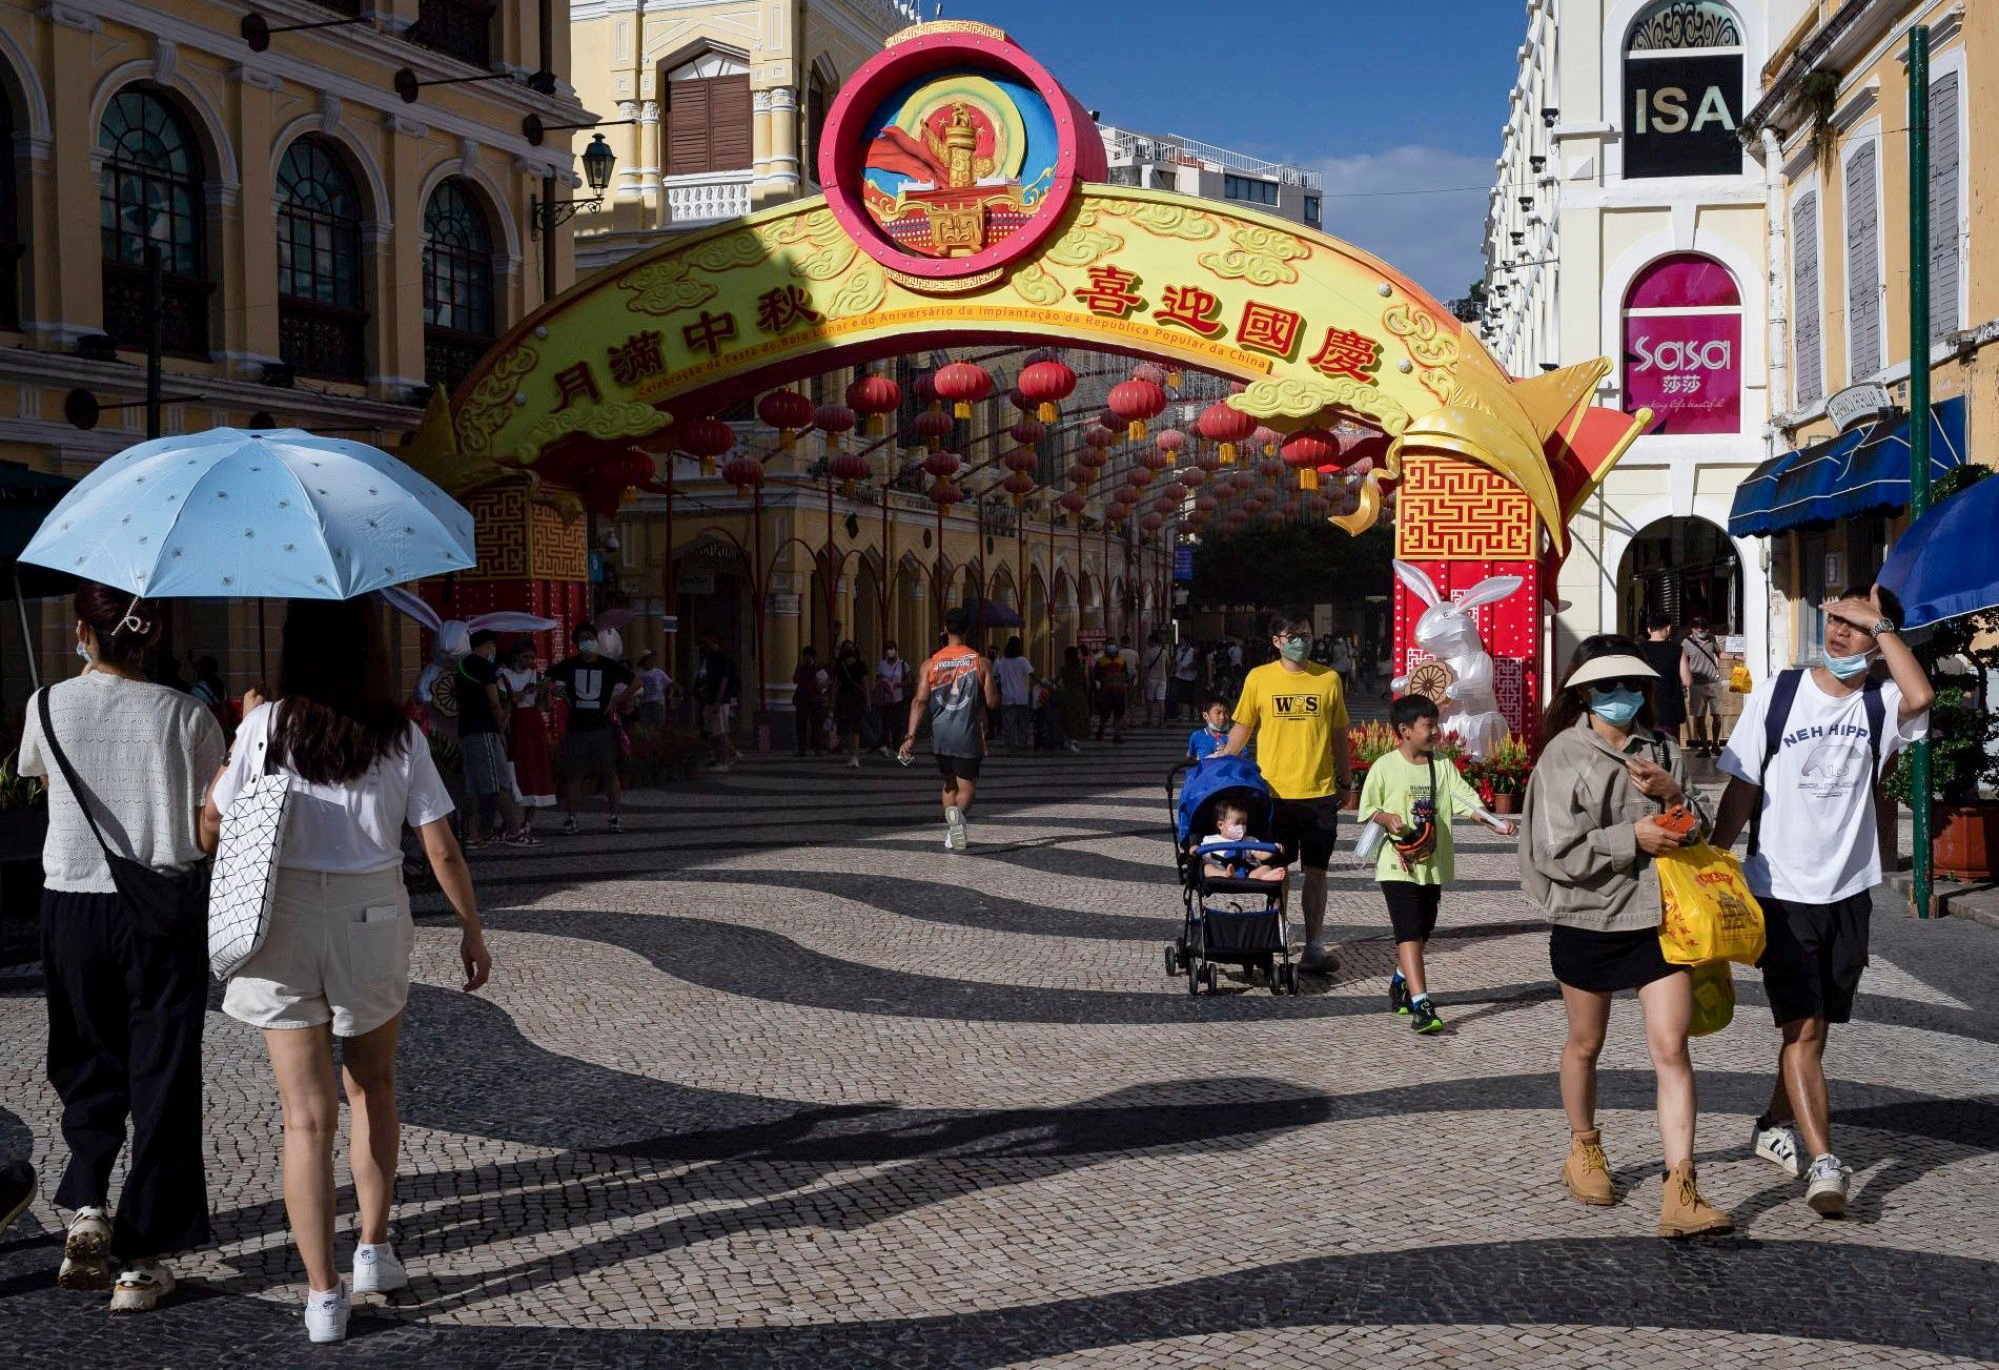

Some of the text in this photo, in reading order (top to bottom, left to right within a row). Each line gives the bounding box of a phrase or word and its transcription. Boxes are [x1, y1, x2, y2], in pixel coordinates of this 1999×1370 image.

[1635, 85, 1736, 134] ISA
[550, 284, 826, 413] 月滿中秋
[638, 366, 703, 396] Celebração
[706, 359, 721, 370] da
[724, 348, 759, 365] Festa
[761, 341, 777, 352] do
[781, 331, 809, 348] Bolo
[812, 321, 848, 339] Lunar
[861, 316, 875, 325] do
[879, 305, 954, 321] Aniversário
[958, 304, 974, 315] da
[979, 304, 1060, 321] Implantação
[1064, 312, 1080, 323] da
[1085, 315, 1149, 336] República
[1155, 328, 1205, 350] Popular
[1208, 341, 1224, 356] da
[1229, 350, 1265, 369] China
[1072, 265, 1379, 383] 喜迎國慶
[1662, 374, 1701, 394] 莎莎
[1782, 724, 1872, 748] NEH HIPP
